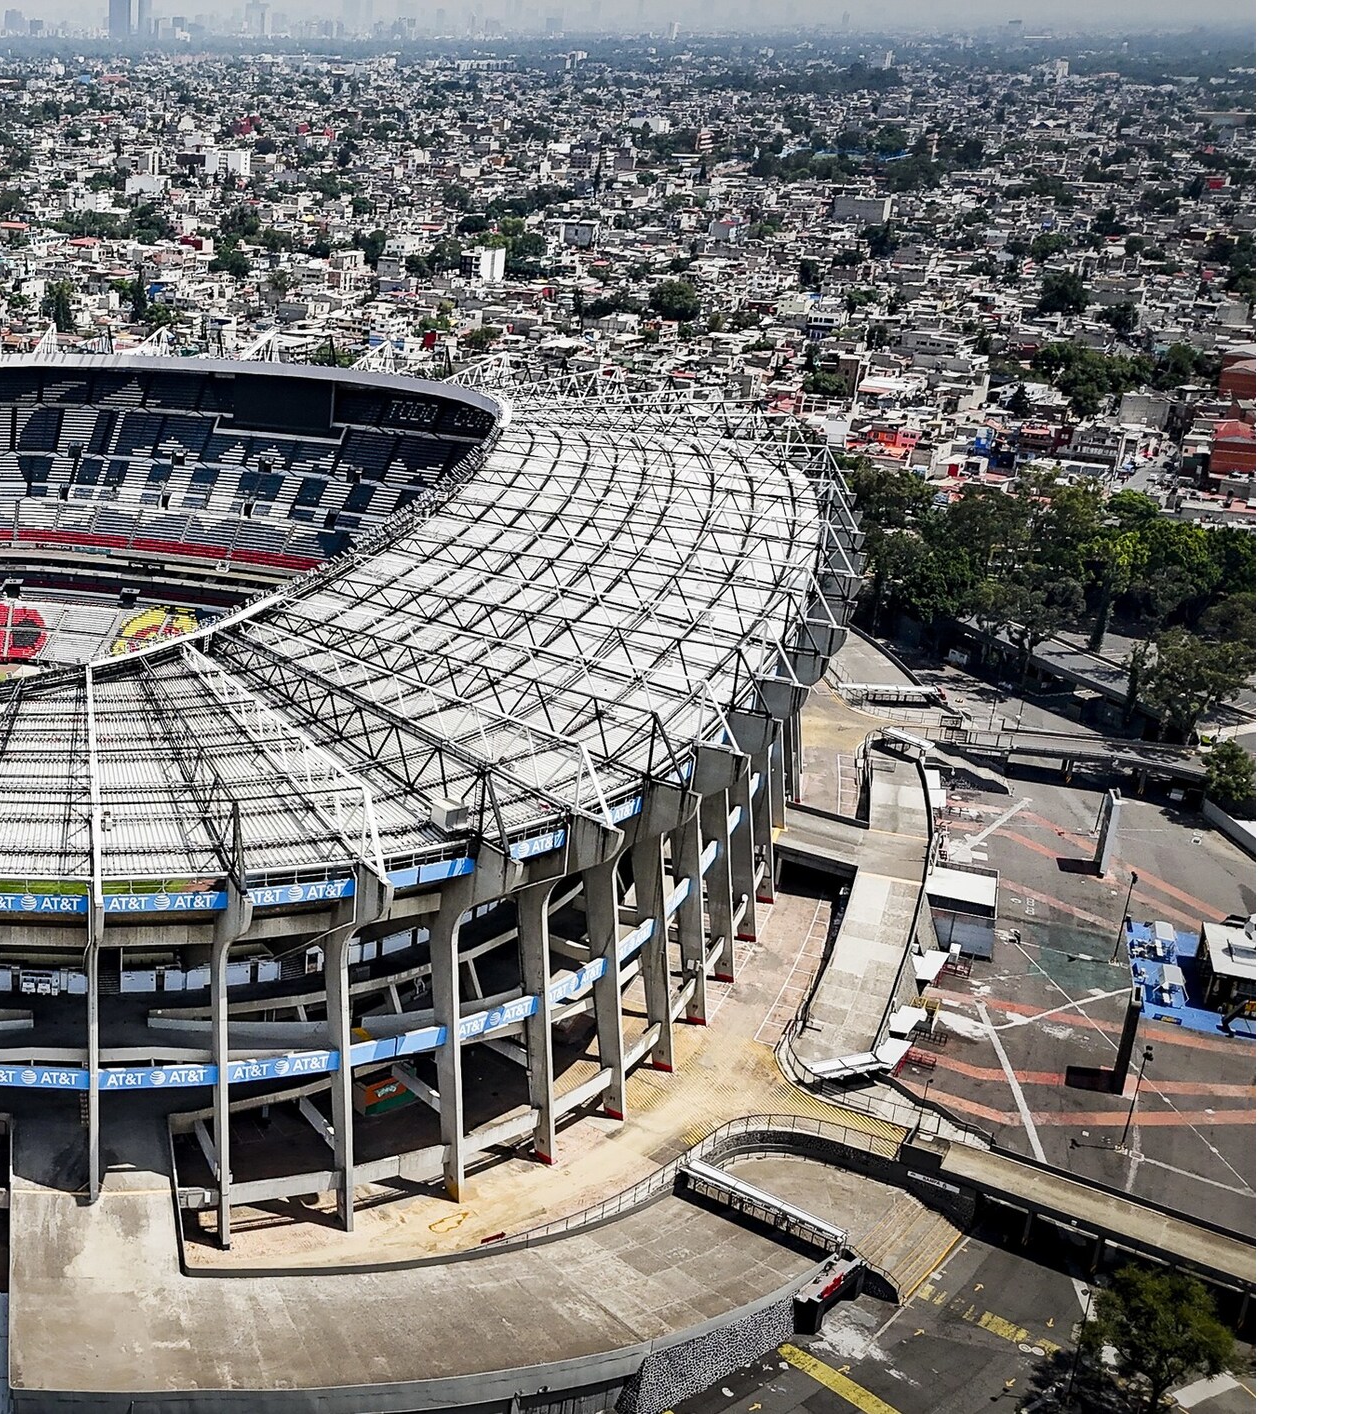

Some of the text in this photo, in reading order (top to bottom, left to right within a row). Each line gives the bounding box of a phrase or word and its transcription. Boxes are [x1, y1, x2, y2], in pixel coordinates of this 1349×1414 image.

[307, 882, 345, 899] AT&T
[41, 897, 81, 910] AT&T
[109, 895, 214, 909] AT&T AT&T
[460, 1005, 531, 1037] AT&T AT&T
[234, 1057, 328, 1079] AT&T AT&T
[41, 1072, 78, 1085] AT&T
[107, 1070, 207, 1086] AT&T AT&T
